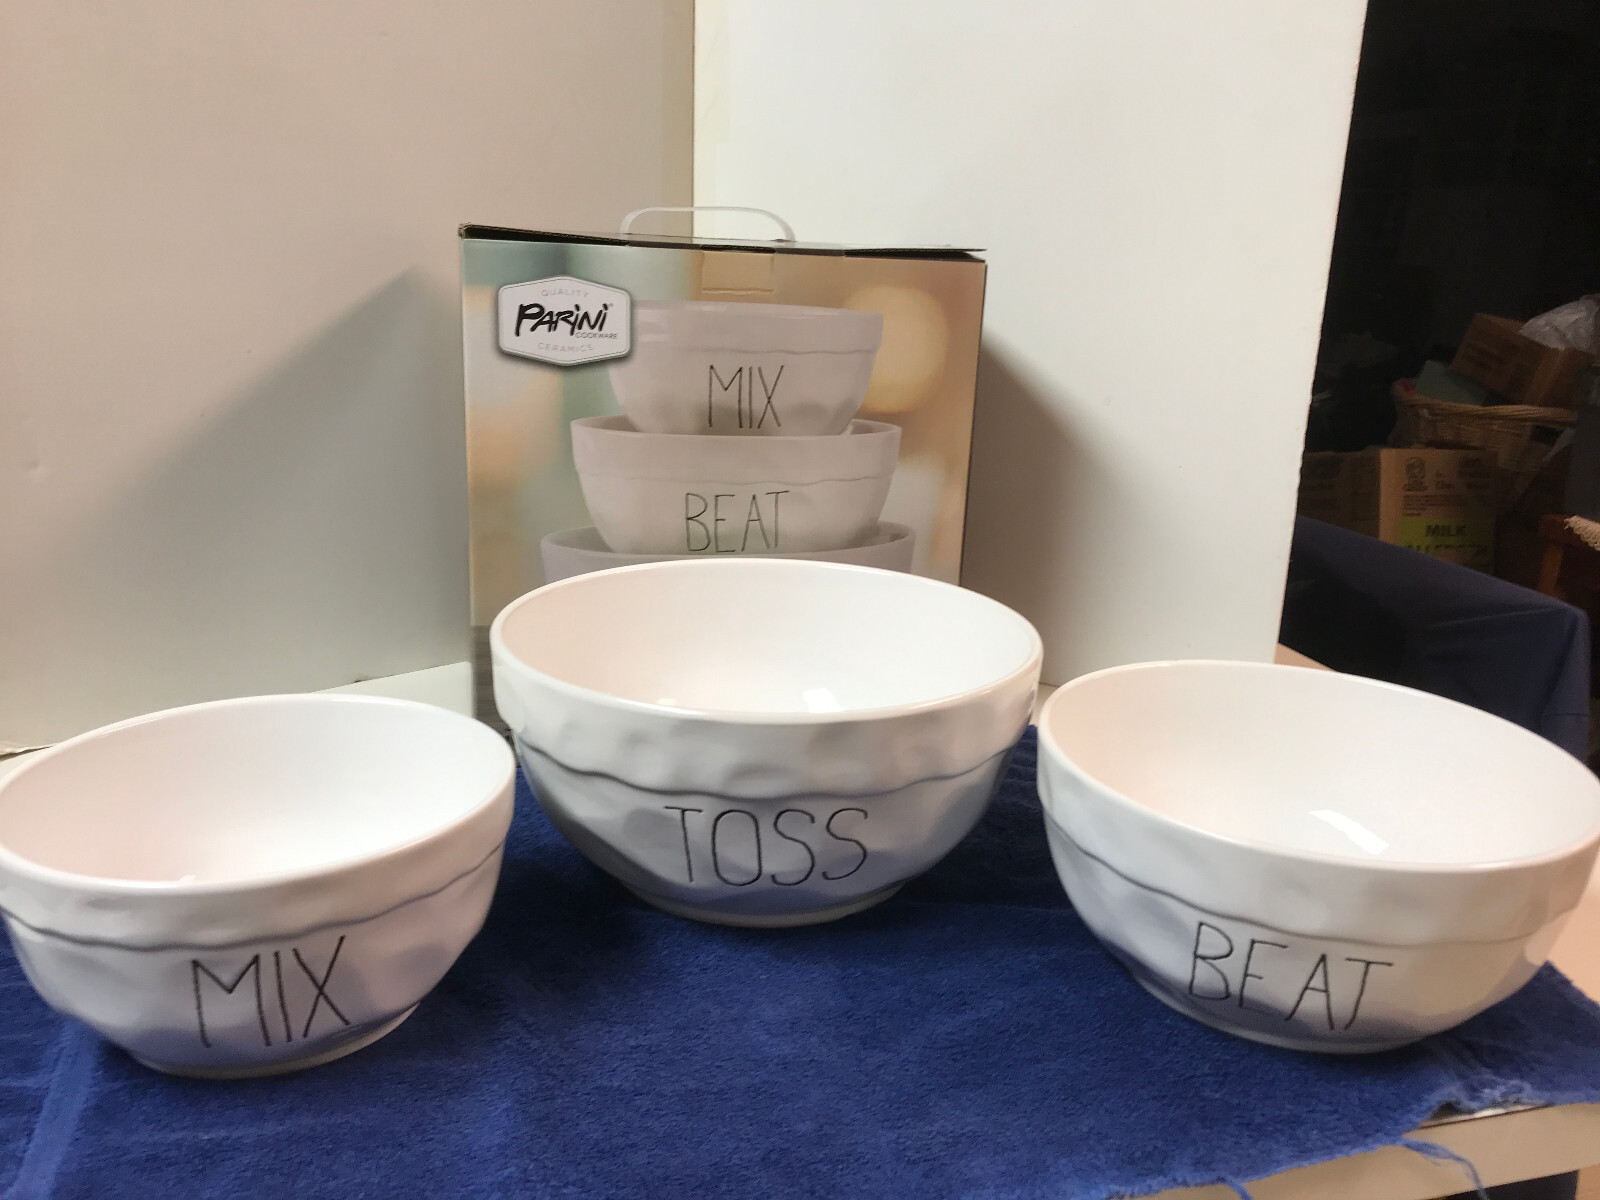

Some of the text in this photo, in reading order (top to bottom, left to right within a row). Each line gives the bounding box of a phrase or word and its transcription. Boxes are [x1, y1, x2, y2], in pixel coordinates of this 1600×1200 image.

[537, 342, 593, 352] CERAMICS
[708, 364, 785, 430] MIX
[685, 490, 790, 553] BEAT
[1425, 524, 1467, 538] MILK
[663, 805, 869, 887] TOSS
[191, 934, 352, 1049] MIX
[1188, 921, 1395, 1031] BEAT
